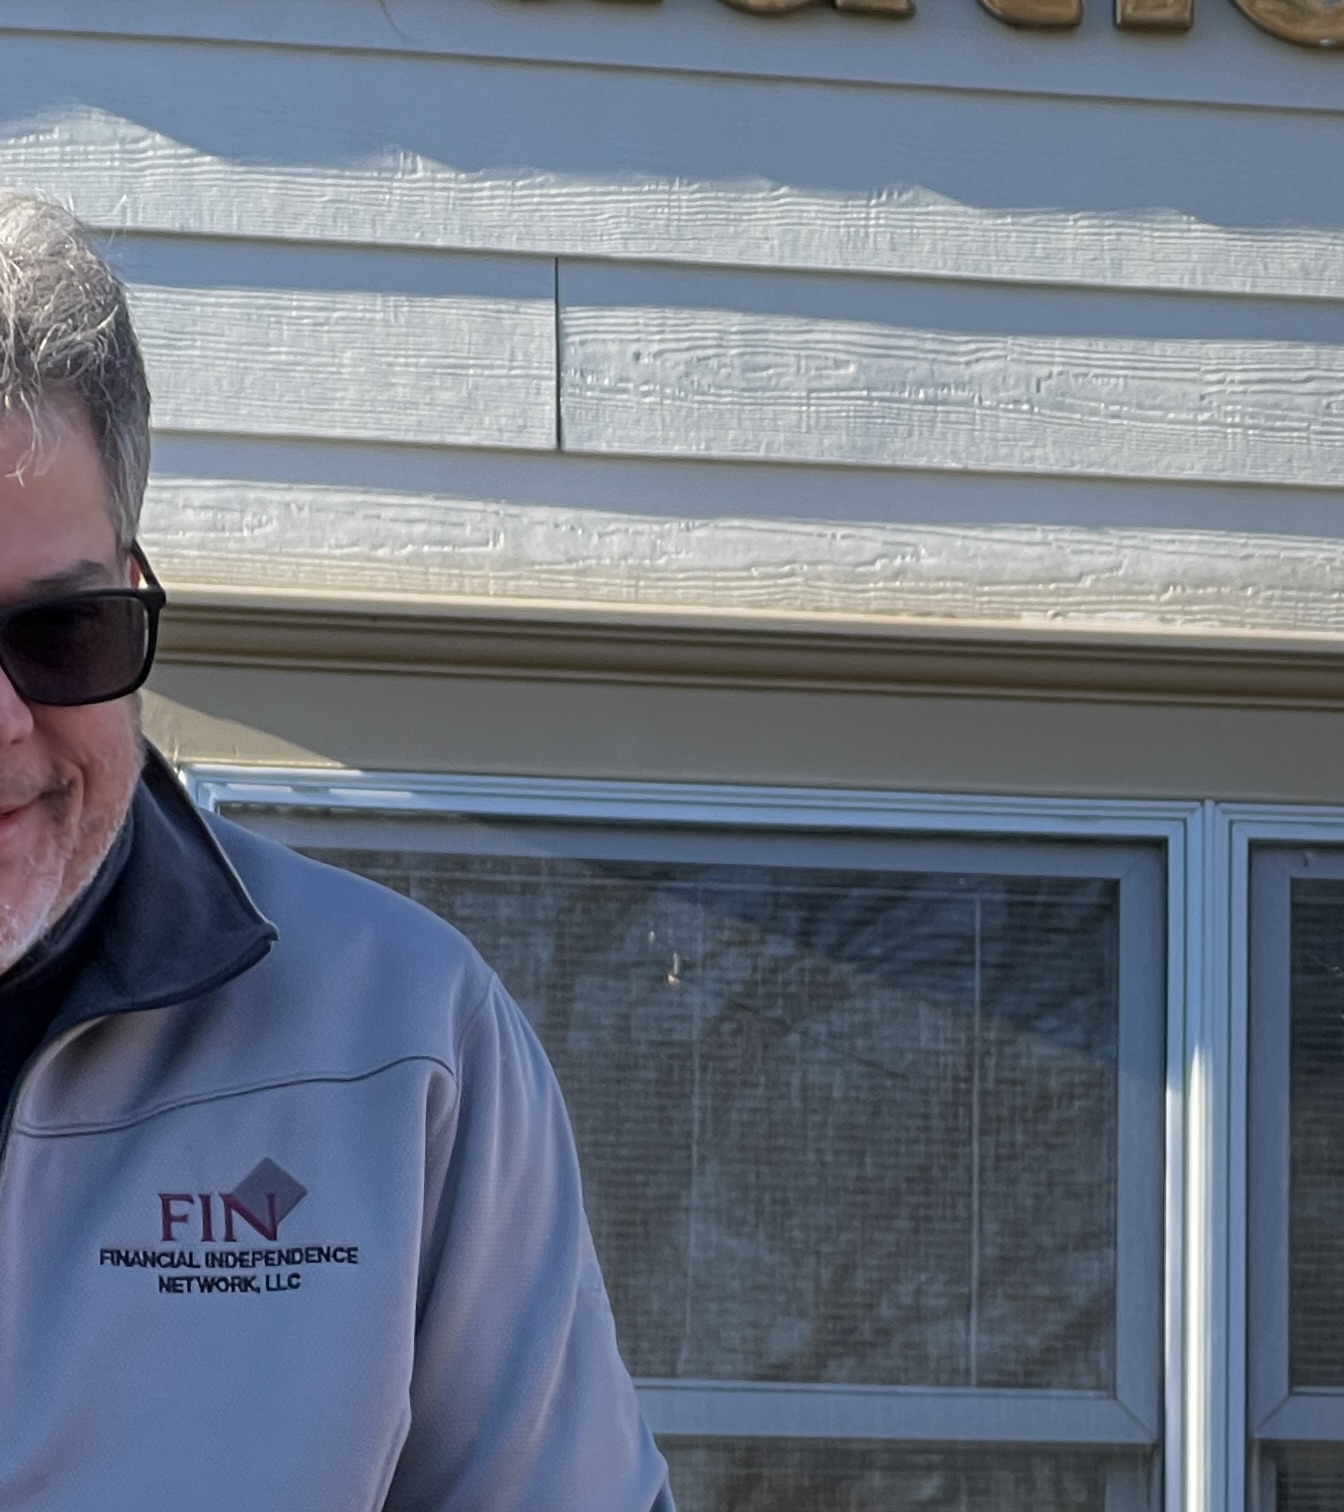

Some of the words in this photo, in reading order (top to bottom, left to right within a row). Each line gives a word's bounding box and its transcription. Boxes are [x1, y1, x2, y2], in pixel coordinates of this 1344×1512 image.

[157, 1192, 277, 1242] FIN
[100, 1248, 200, 1269] FINANCIAL
[205, 1247, 359, 1268] INDEPENDENCE
[158, 1275, 260, 1294] NETWORK,
[265, 1272, 301, 1291] LLC
